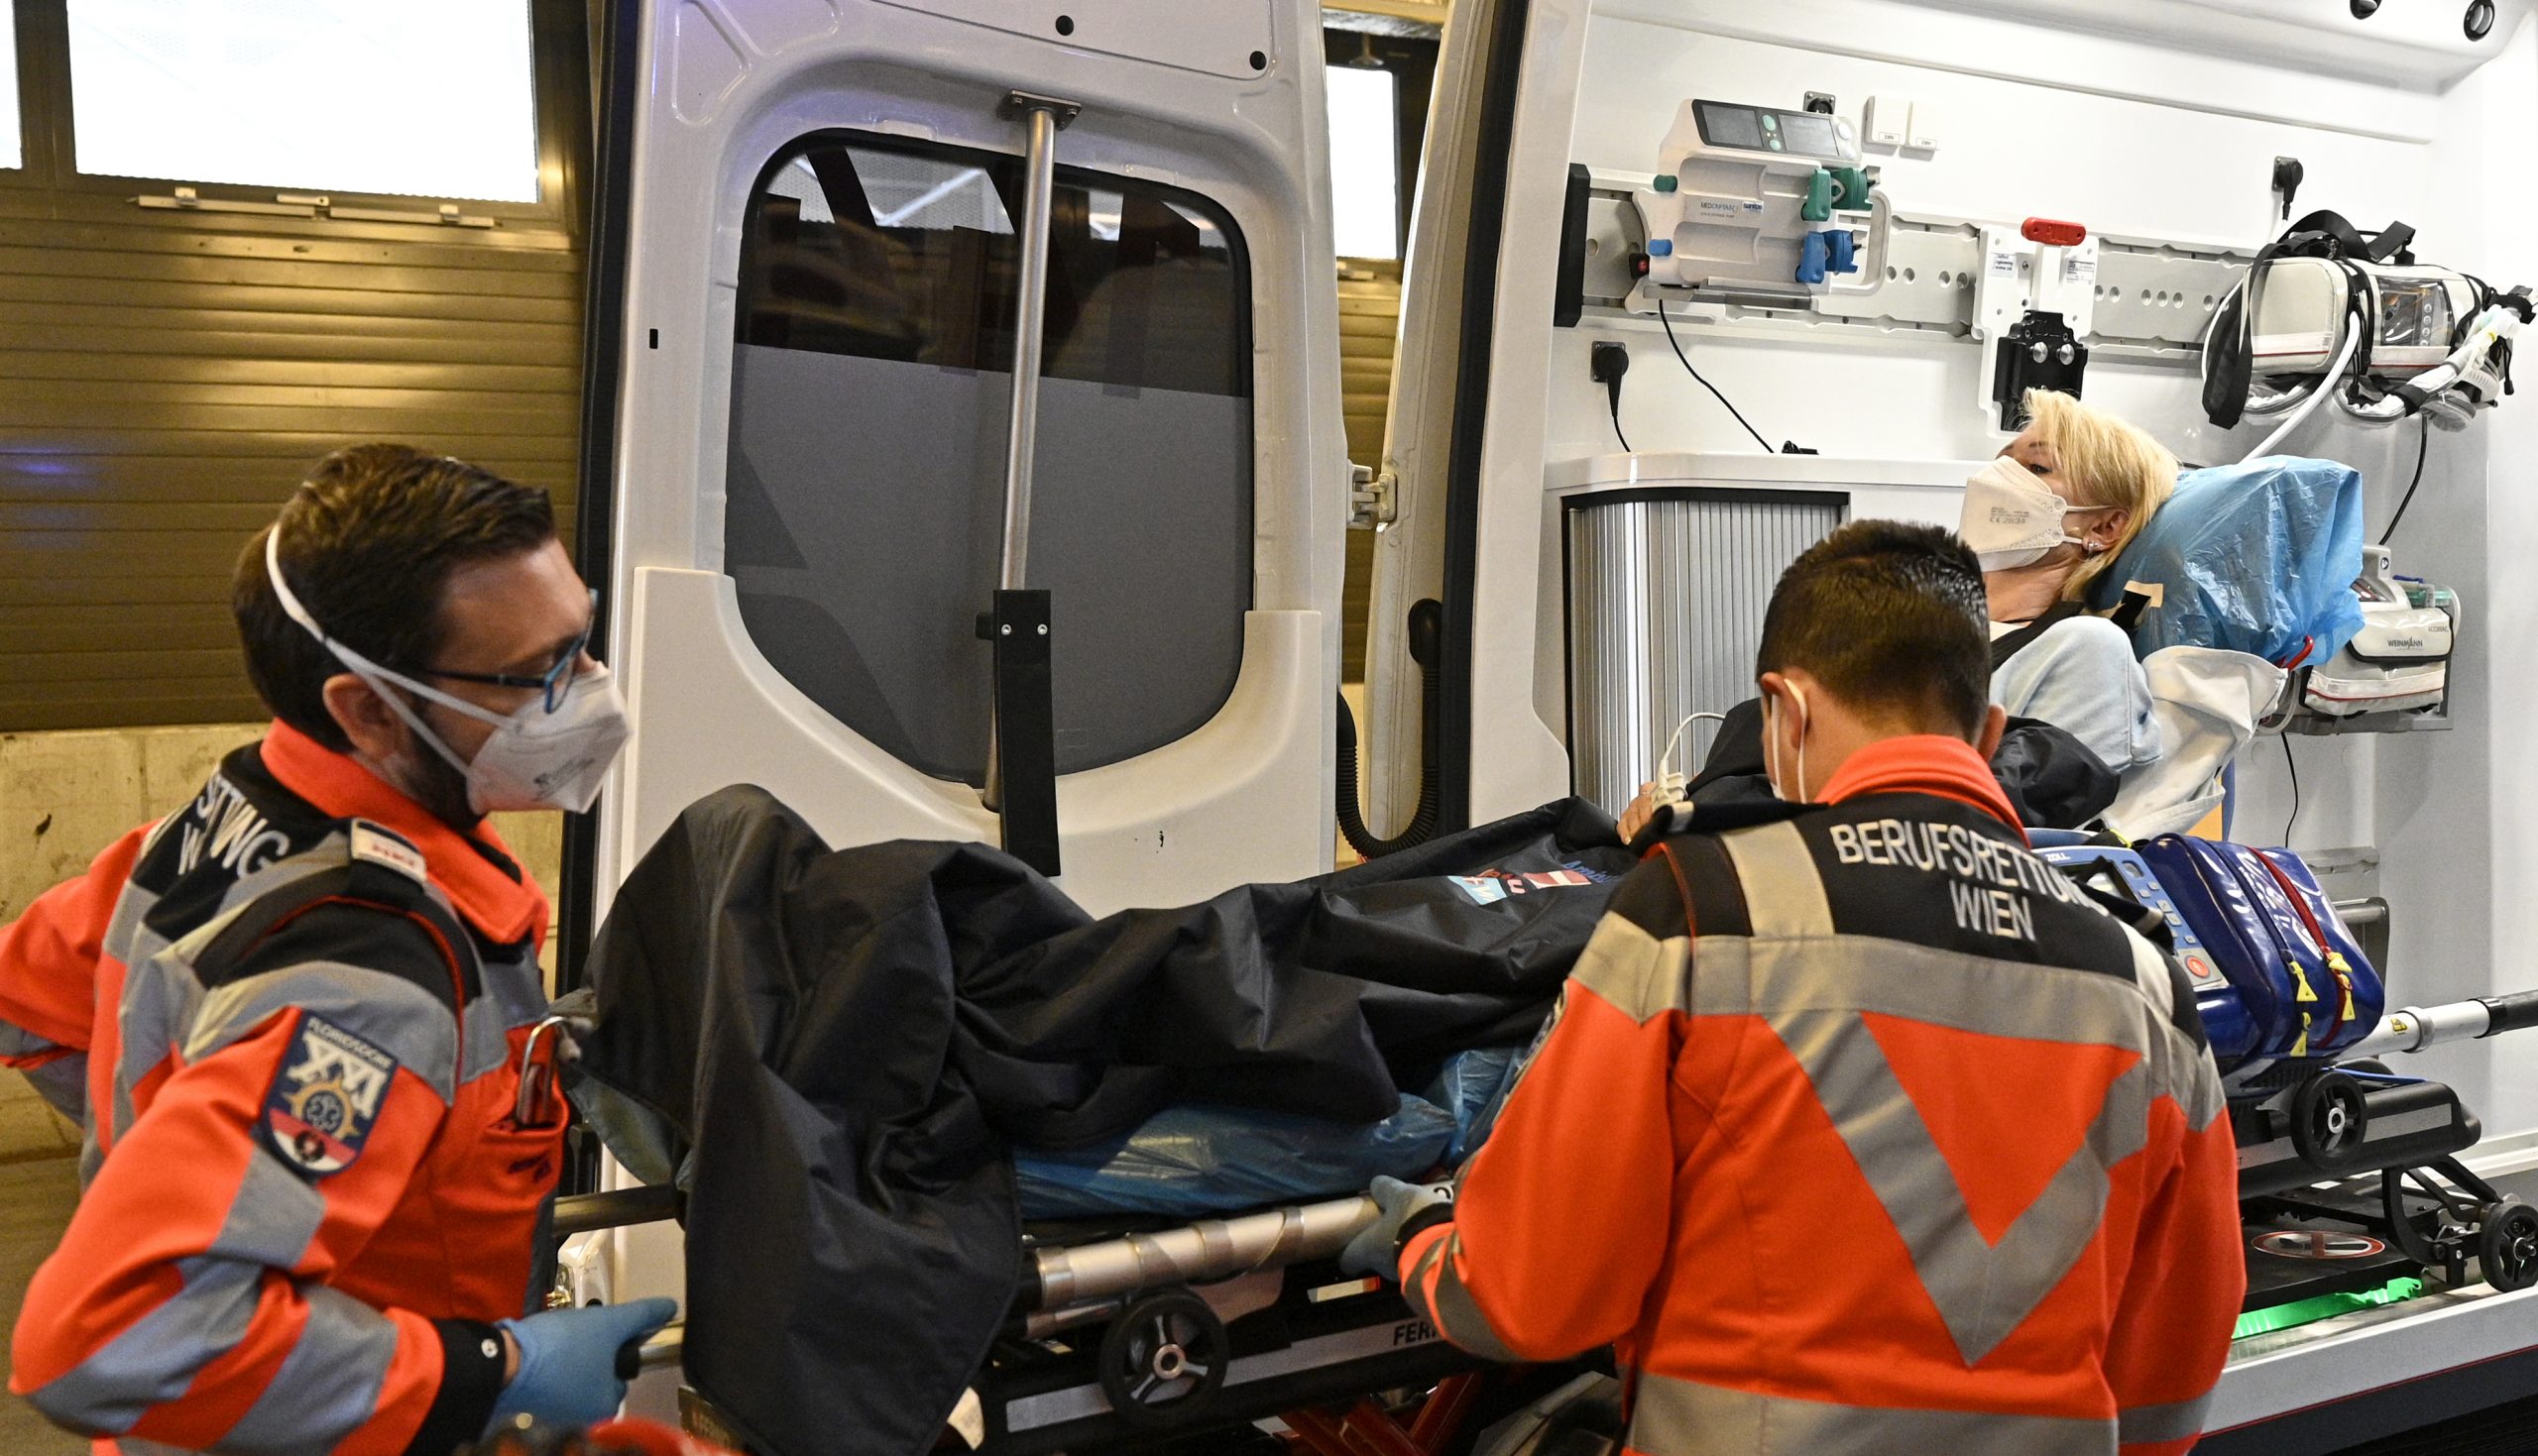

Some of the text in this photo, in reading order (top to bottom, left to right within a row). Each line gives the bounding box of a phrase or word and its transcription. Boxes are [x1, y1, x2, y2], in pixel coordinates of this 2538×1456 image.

[2387, 635, 2423, 650] WEINMANN
[2045, 852, 2071, 862] ZOLL
[1949, 878, 2036, 942] WIEN
